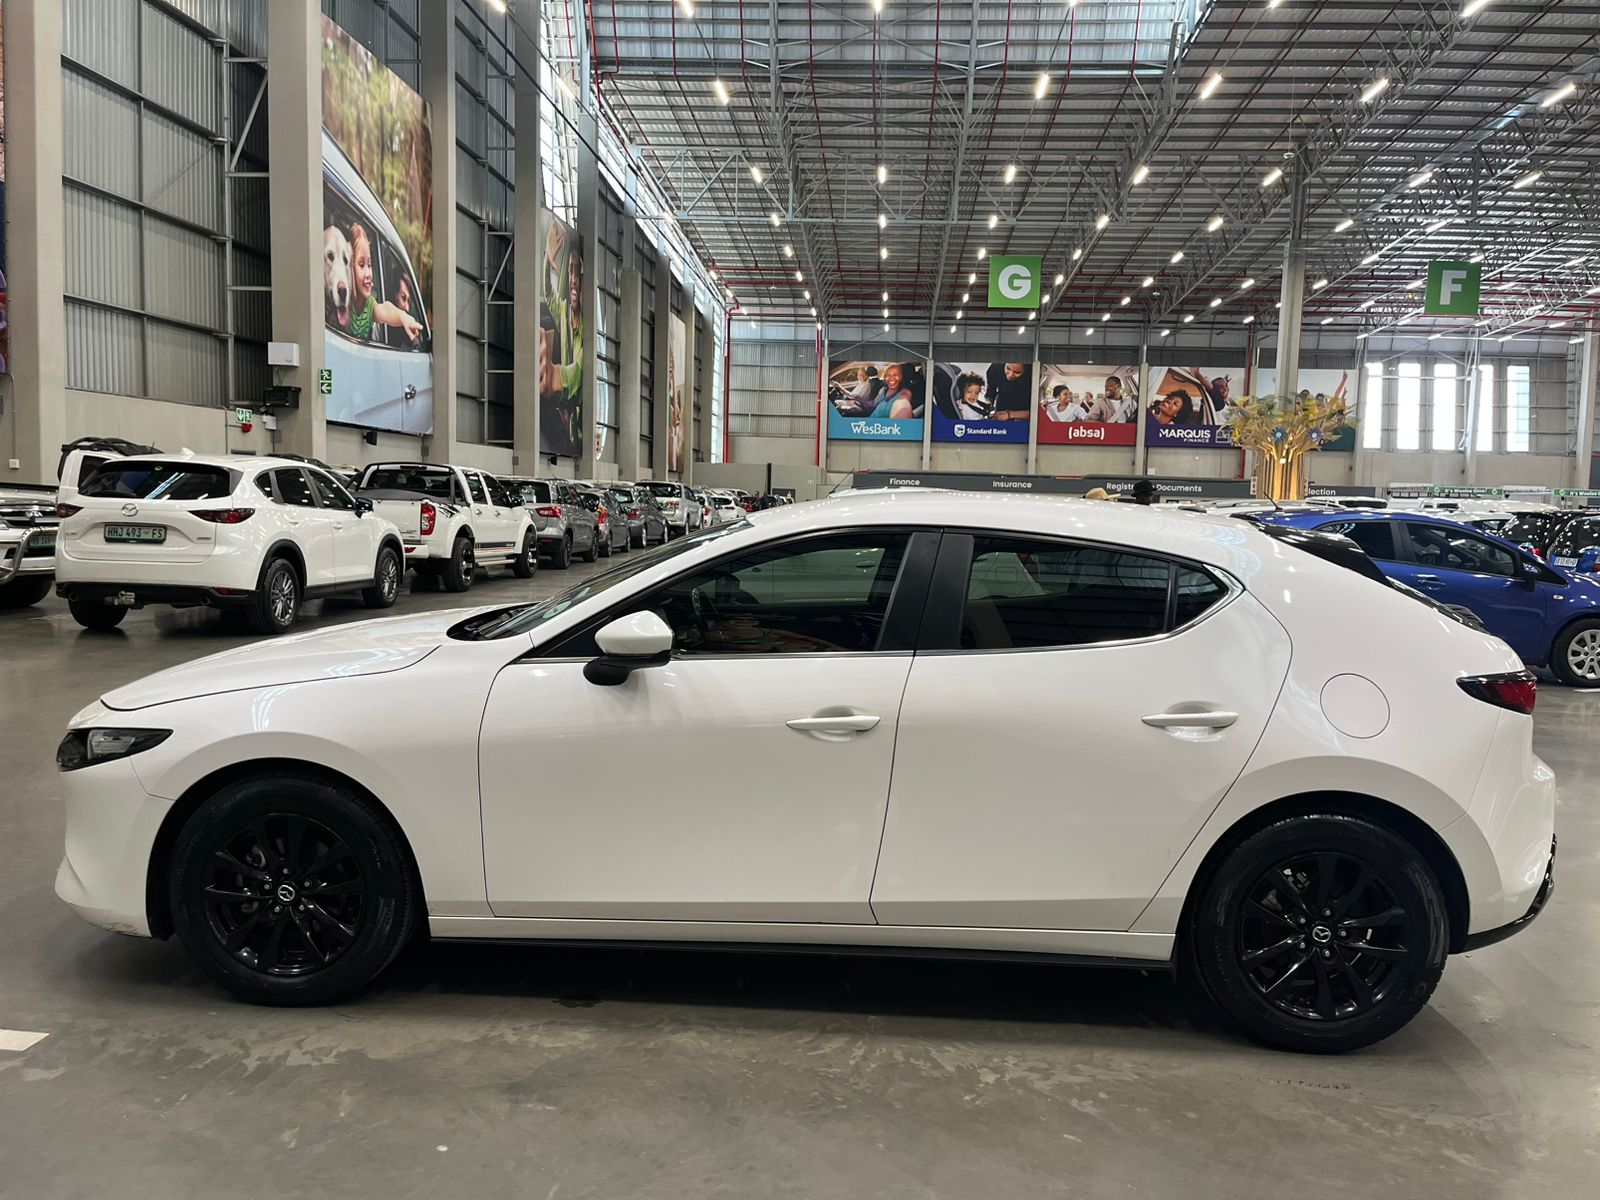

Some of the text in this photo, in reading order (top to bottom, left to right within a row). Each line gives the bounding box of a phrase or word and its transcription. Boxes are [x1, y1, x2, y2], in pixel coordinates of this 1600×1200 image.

[998, 264, 1031, 299] G
[1440, 270, 1467, 305] F
[850, 421, 901, 436] WesBank
[967, 427, 992, 435] Standard
[1159, 428, 1211, 439] MARQUIS
[889, 477, 921, 486] Finance
[992, 480, 1032, 488] Insurance
[1156, 484, 1202, 492] Documents
[126, 527, 141, 537] 493
[152, 528, 163, 538] FS
